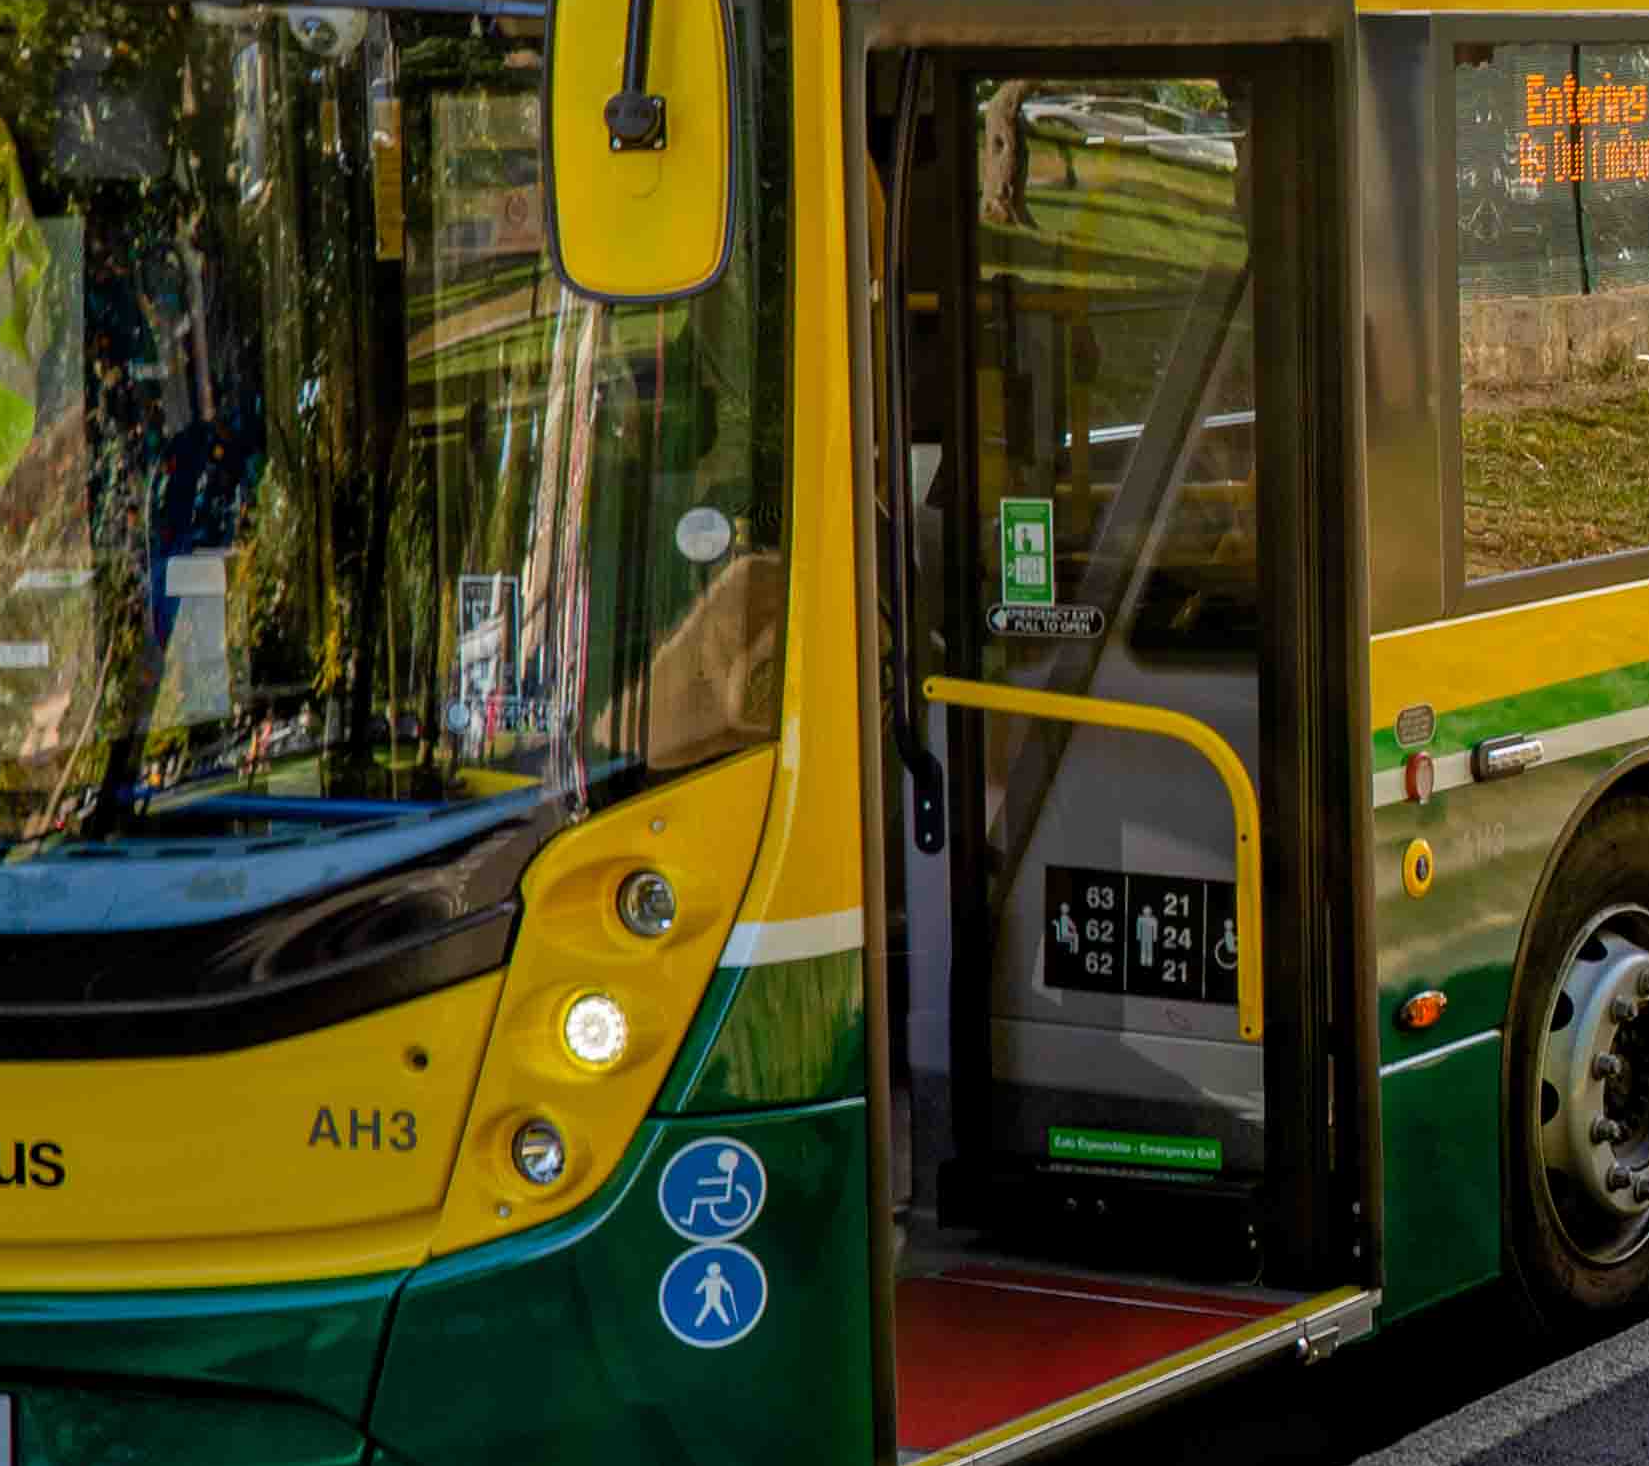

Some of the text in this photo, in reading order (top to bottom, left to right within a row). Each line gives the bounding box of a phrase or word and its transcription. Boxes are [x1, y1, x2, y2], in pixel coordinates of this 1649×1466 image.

[1525, 71, 1648, 126] Entering
[1086, 886, 1115, 910] 63
[1163, 892, 1190, 917] 21
[1085, 918, 1114, 943] 62
[1162, 925, 1193, 950] 24
[1085, 951, 1113, 975] 62
[1162, 959, 1188, 983] 21
[307, 1106, 418, 1152] AH3
